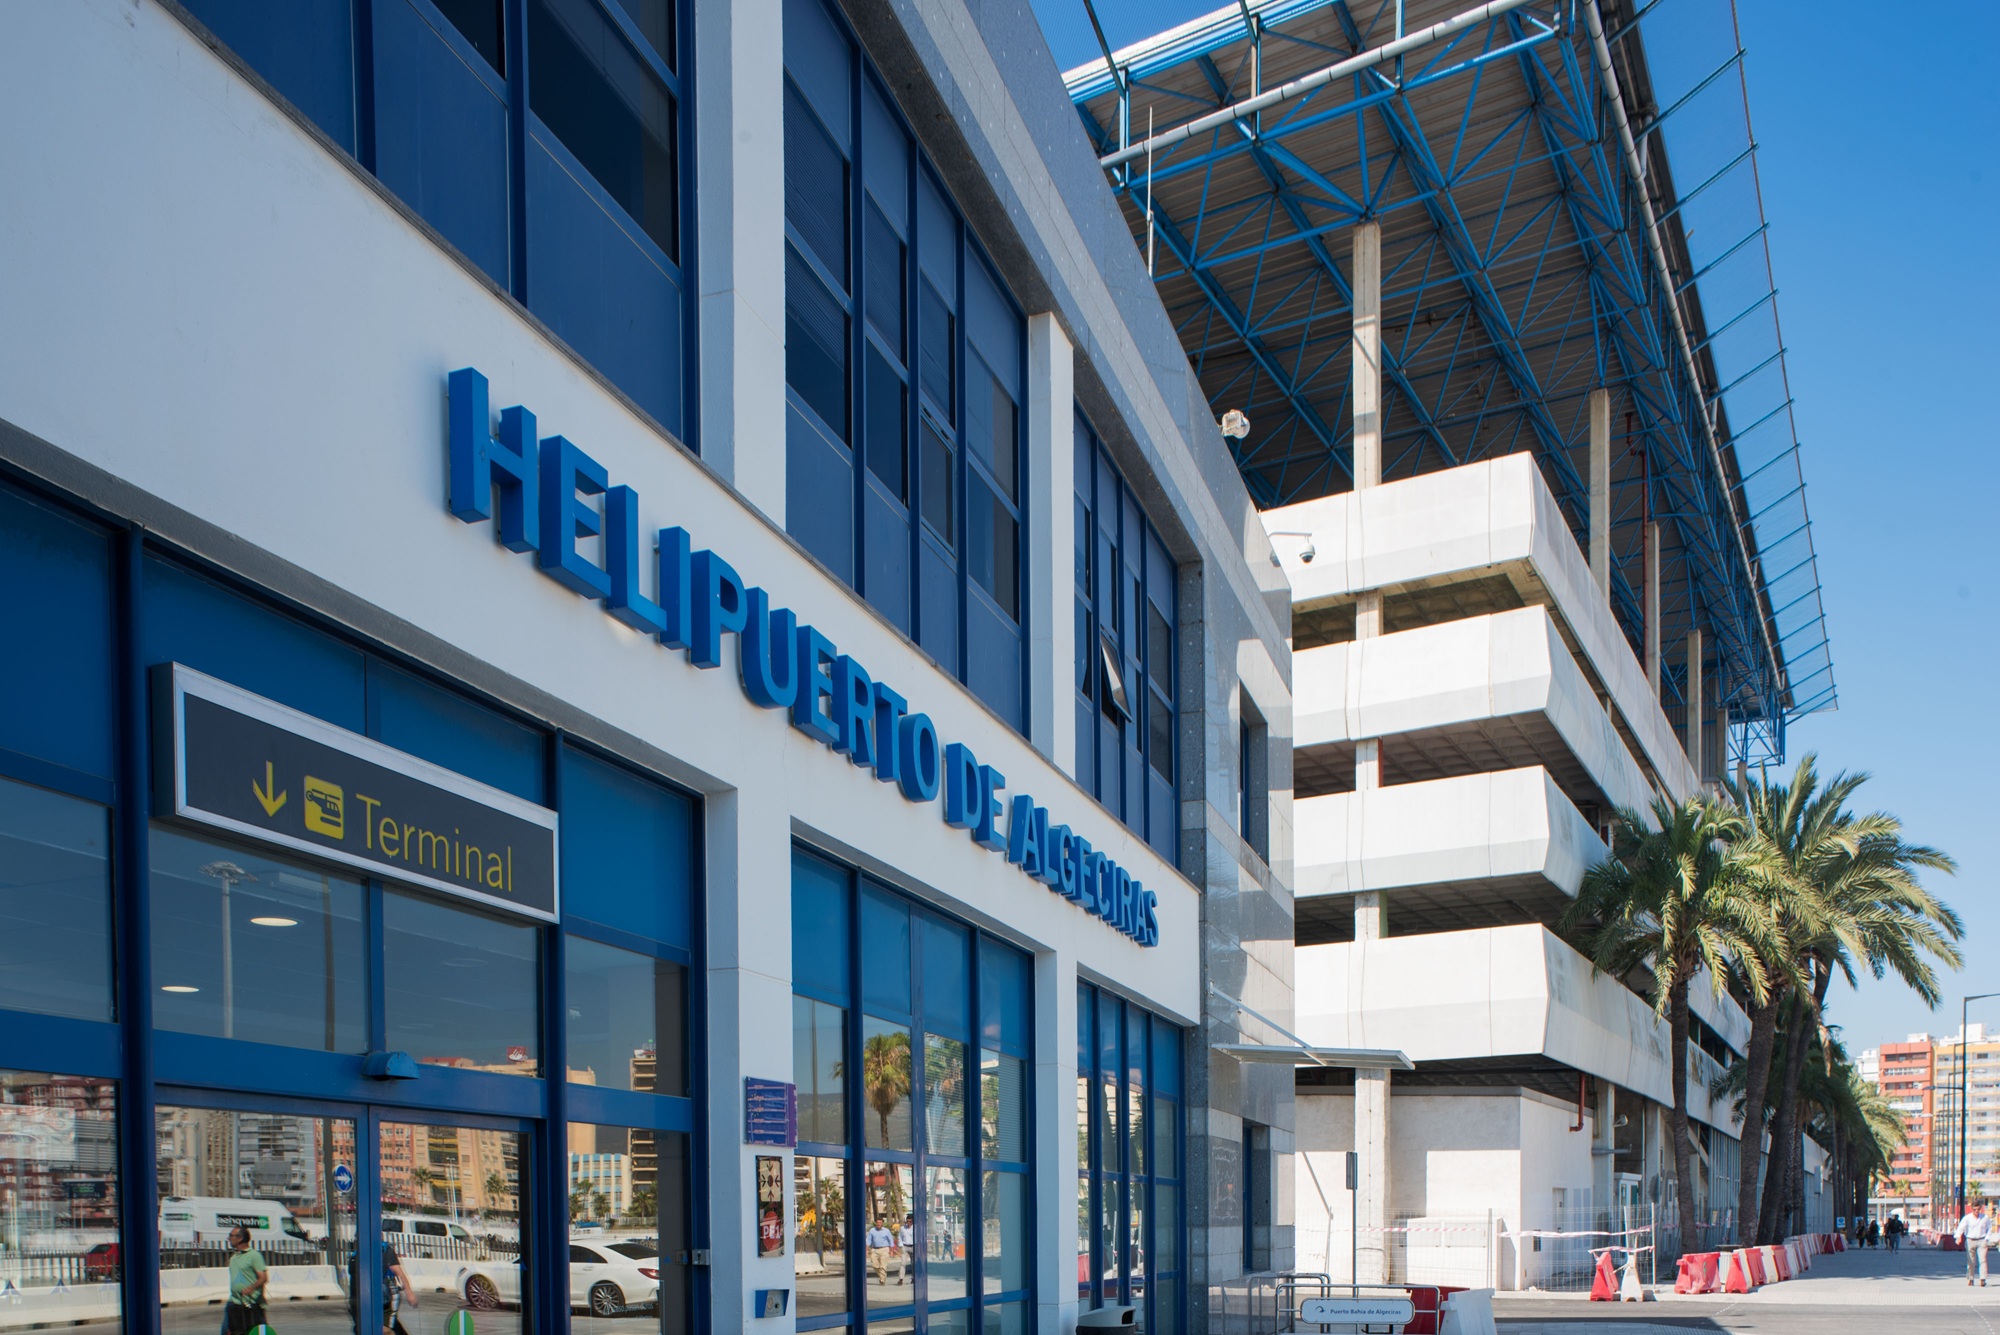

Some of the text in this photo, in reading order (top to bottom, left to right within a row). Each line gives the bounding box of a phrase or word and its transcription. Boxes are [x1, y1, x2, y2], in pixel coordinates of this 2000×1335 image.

[448, 366, 1159, 947] HELIPUERTO DE ALGECIRAS
[355, 792, 513, 893] Terminal
[1375, 1308, 1402, 1316] Algeciras
